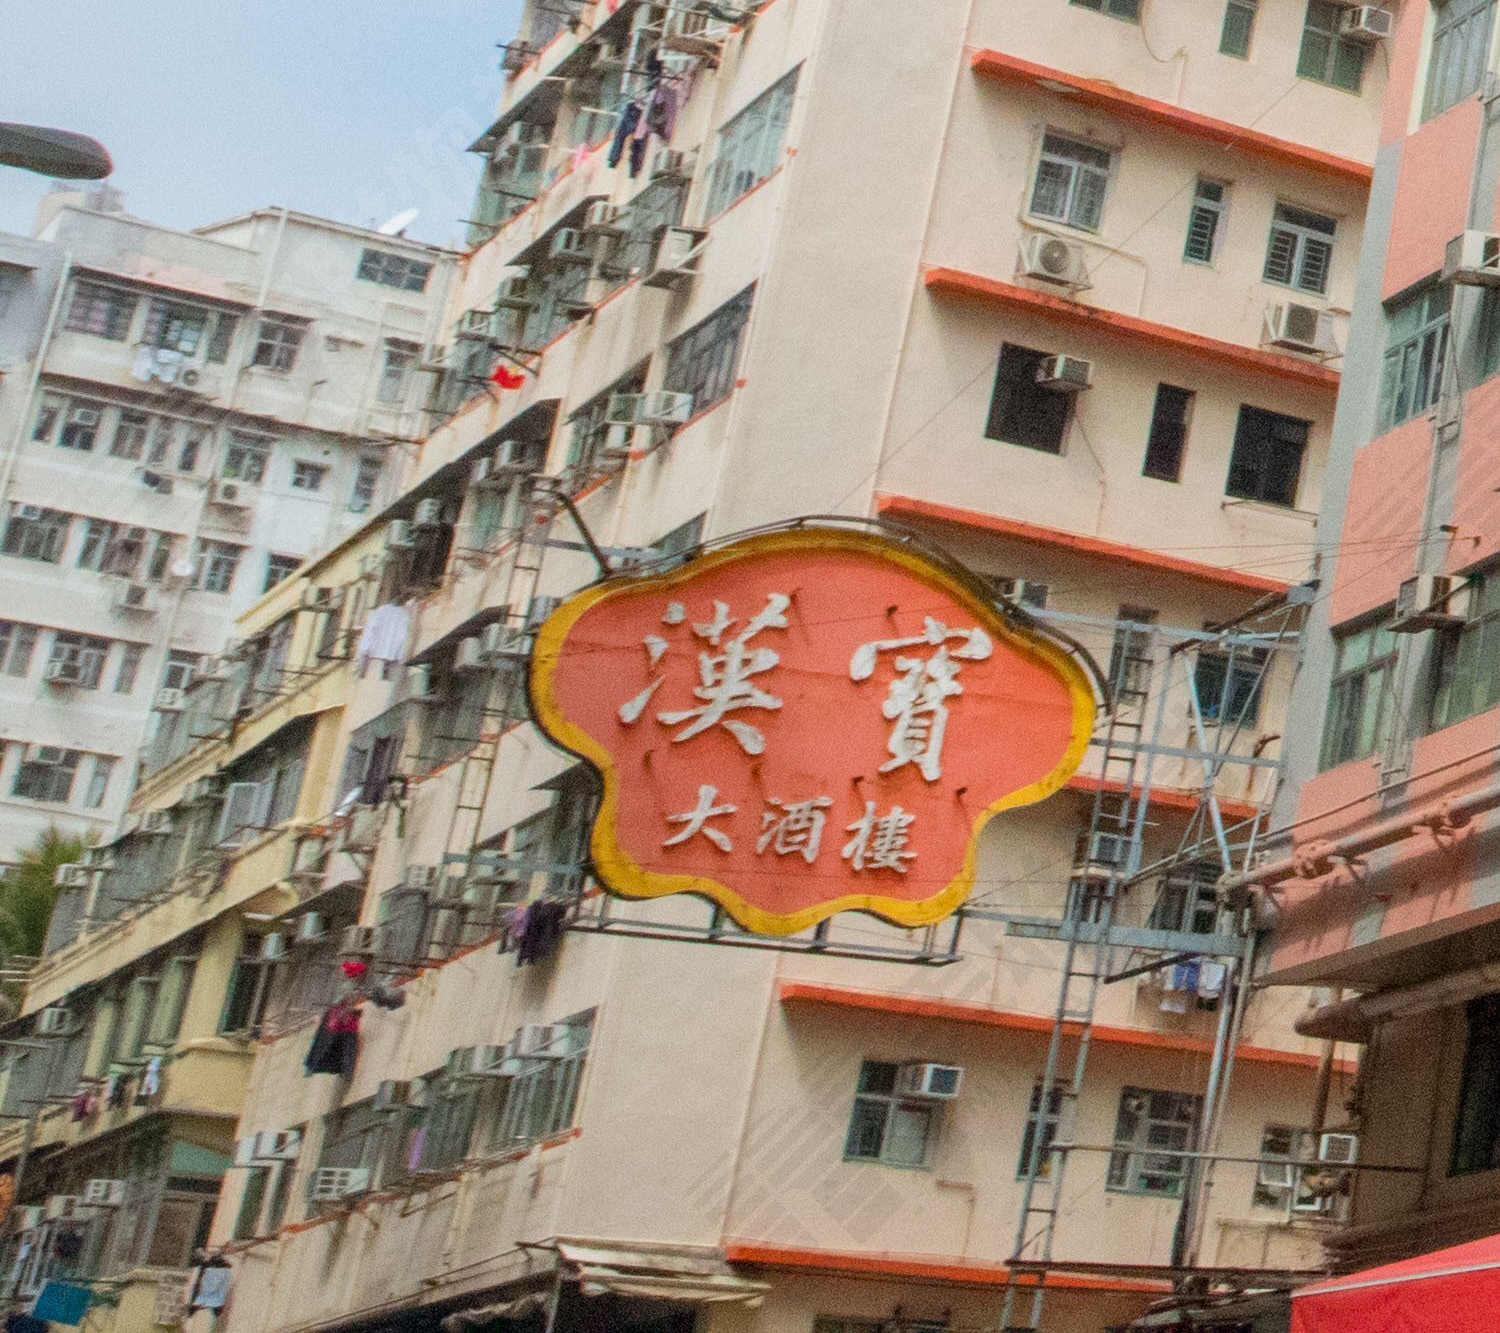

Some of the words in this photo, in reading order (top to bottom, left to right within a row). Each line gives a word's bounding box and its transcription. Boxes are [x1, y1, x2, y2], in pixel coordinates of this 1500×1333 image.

[619, 591, 994, 782] 漢寶
[663, 785, 918, 874] 大酒樓
